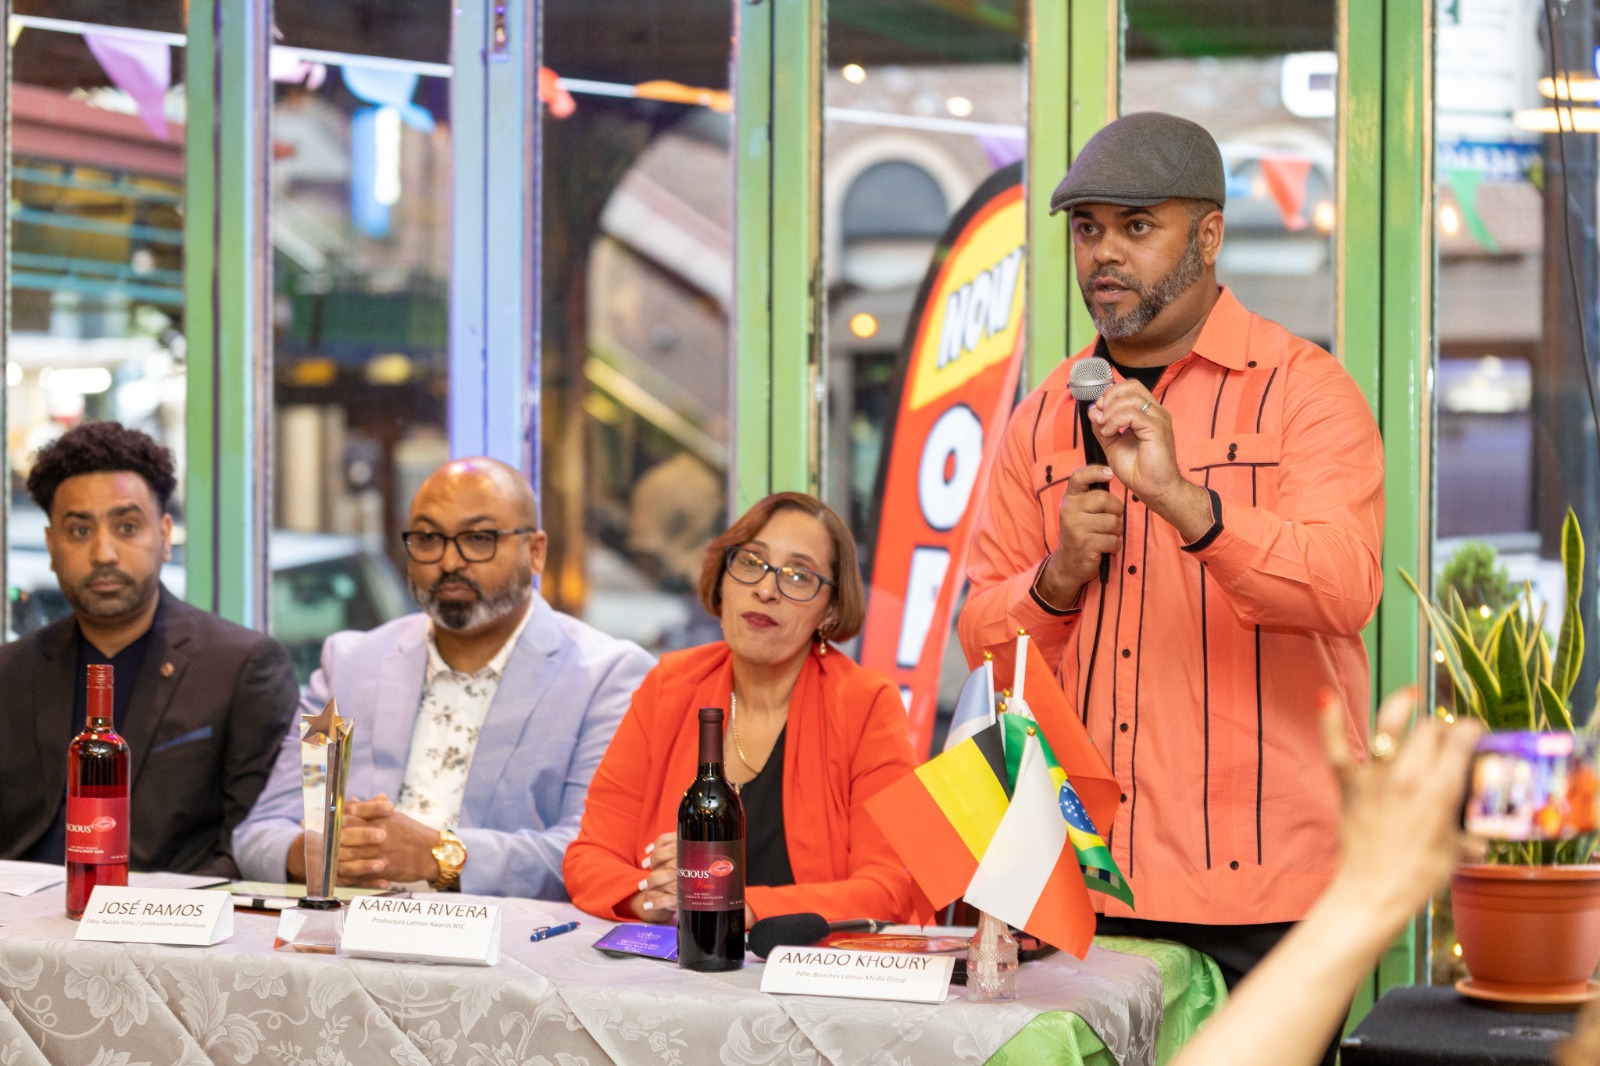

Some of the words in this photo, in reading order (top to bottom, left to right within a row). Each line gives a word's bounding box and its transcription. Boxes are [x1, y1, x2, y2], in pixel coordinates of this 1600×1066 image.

[936, 245, 1025, 371] NOW
[99, 900, 141, 915] JOSÉ
[142, 903, 204, 917] RAMOS
[359, 899, 422, 914] KARINA
[427, 903, 489, 919] RIVERA
[372, 917, 405, 926] Productora
[428, 921, 452, 929] Awards
[778, 952, 851, 966] AMADO
[855, 955, 933, 971] KHOURY
[841, 973, 864, 981] Latinos
[865, 975, 885, 983] Media
[886, 976, 907, 985] Group
